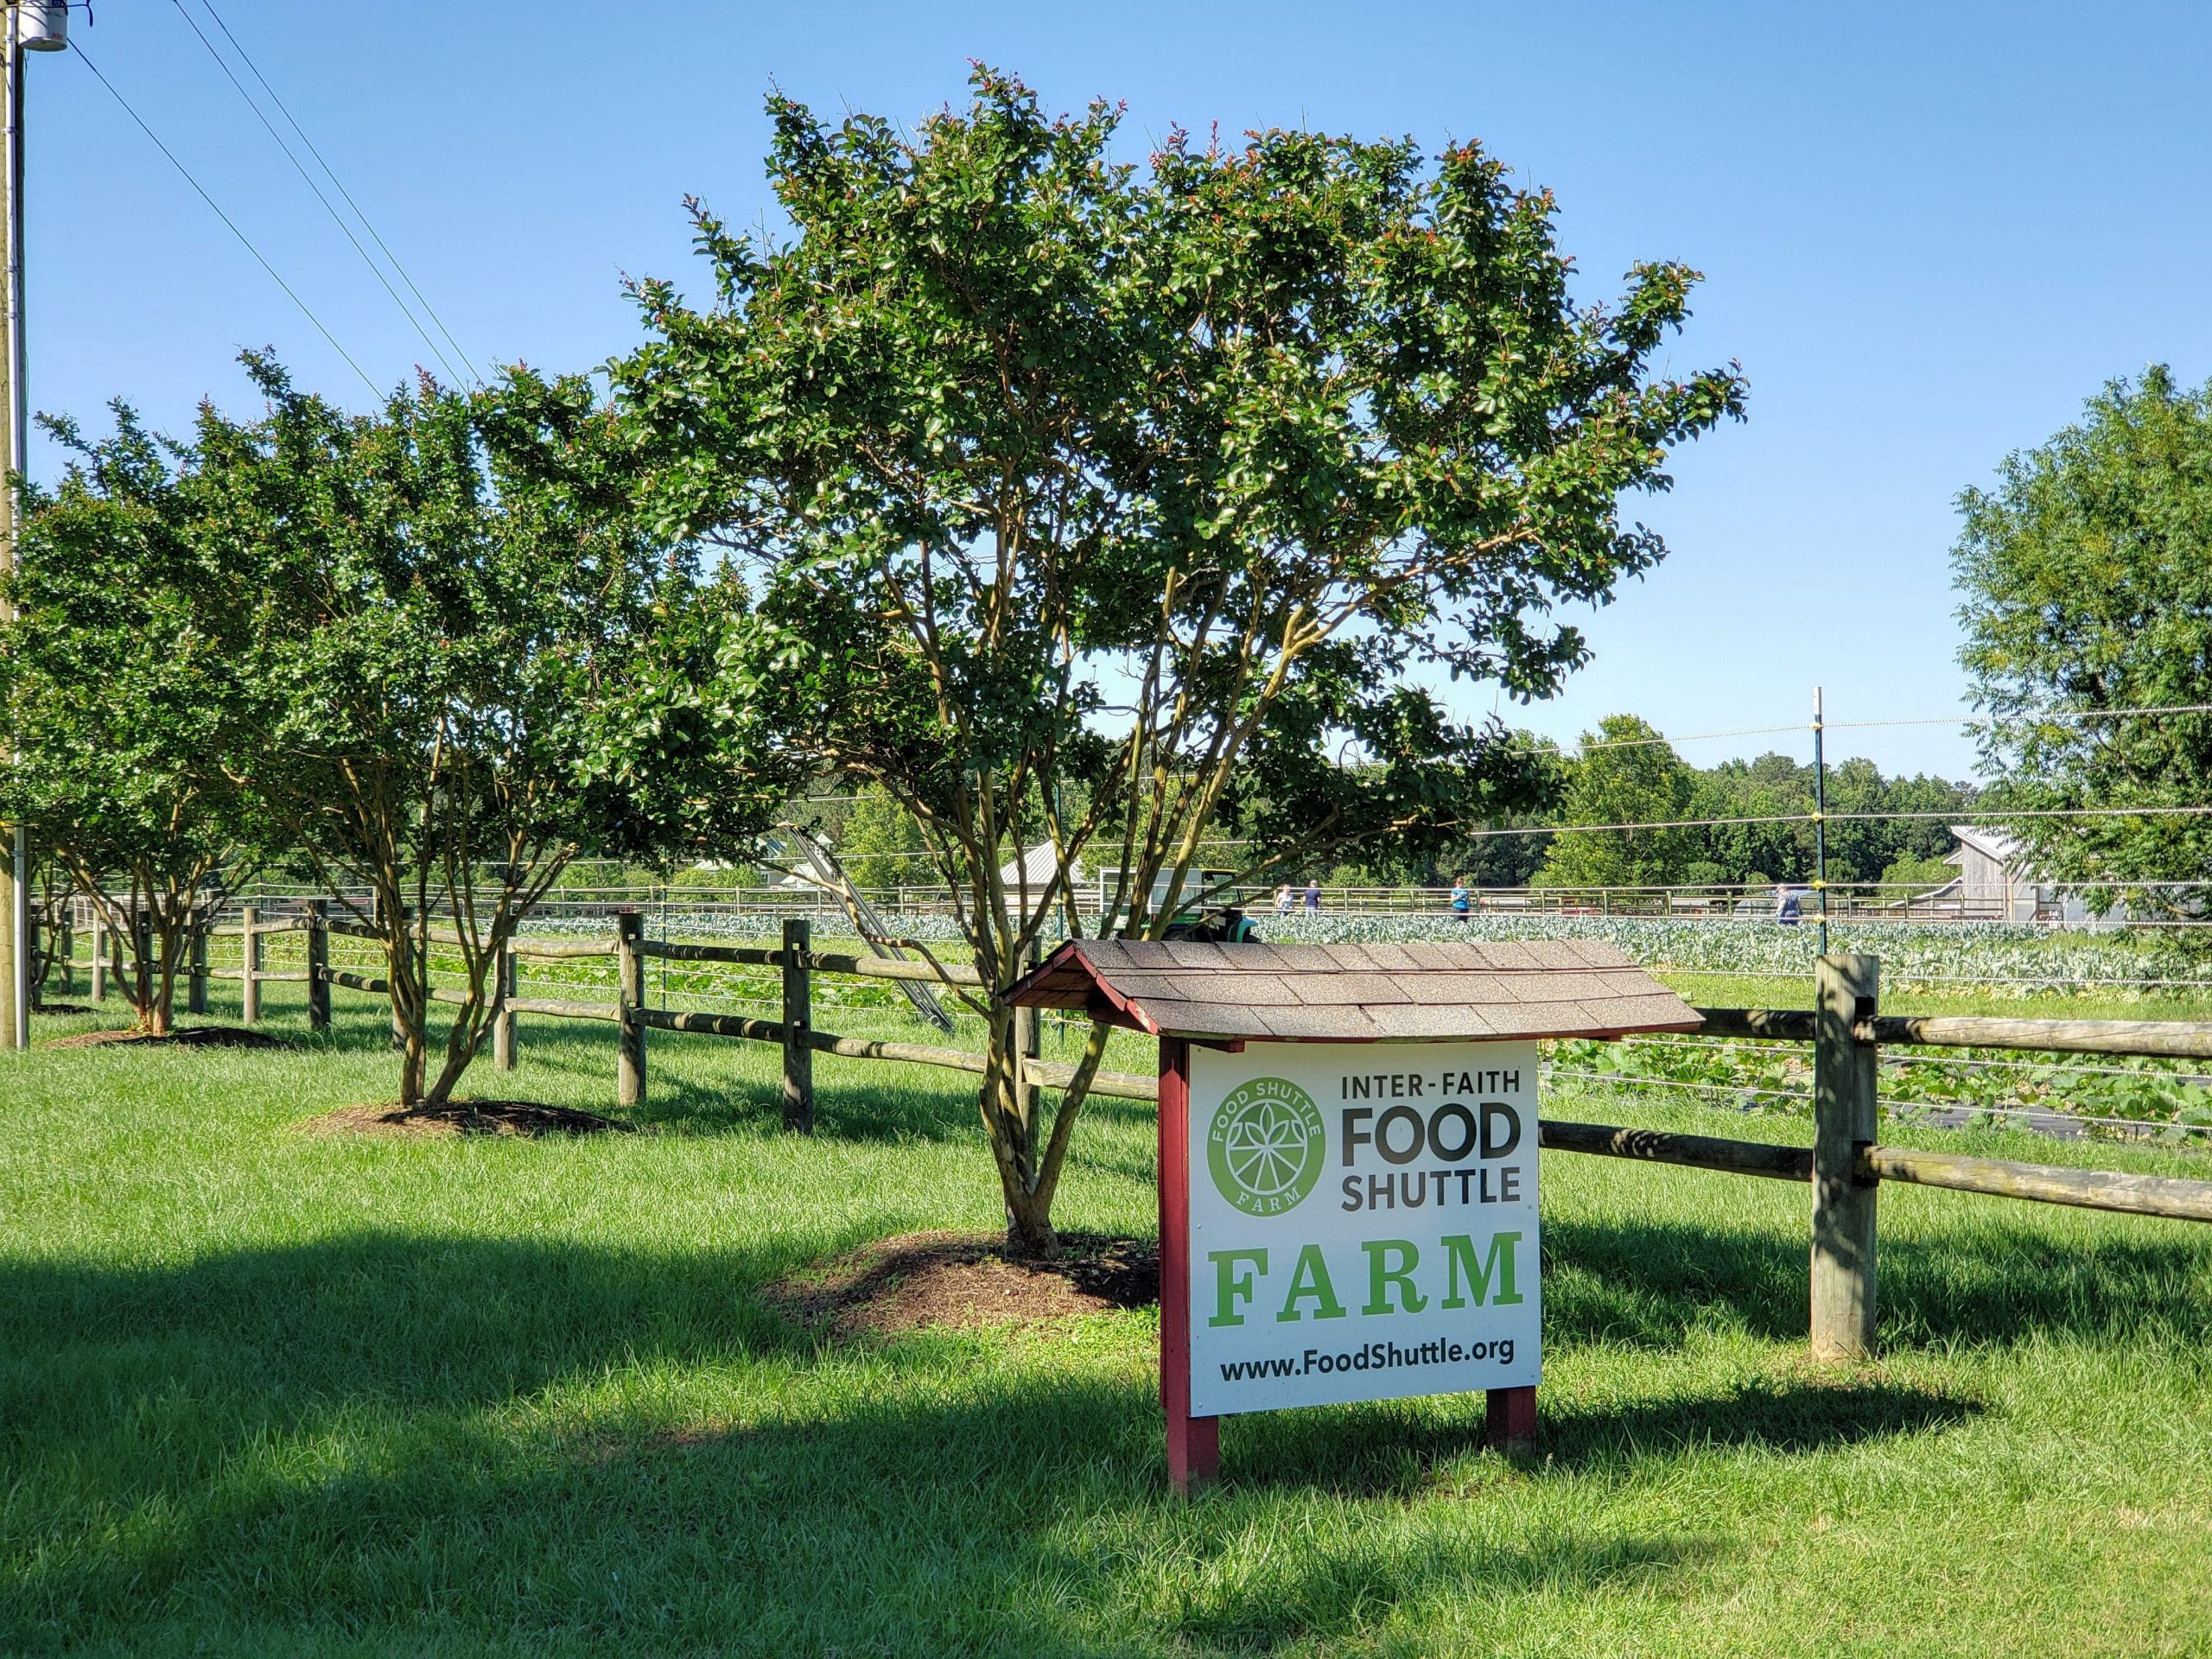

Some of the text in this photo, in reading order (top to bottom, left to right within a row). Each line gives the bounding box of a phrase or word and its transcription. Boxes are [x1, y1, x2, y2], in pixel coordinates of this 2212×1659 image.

[1342, 1070, 1520, 1100] INTER-FAITH
[1212, 1082, 1321, 1142] FOOD SHUTTLE
[1342, 1102, 1522, 1167] FOOD
[1236, 1186, 1301, 1212] FARM
[1341, 1166, 1521, 1212] SHUTTLE
[1207, 1230, 1523, 1328] FARM
[1220, 1337, 1515, 1382] www.FoodShuttle.org
